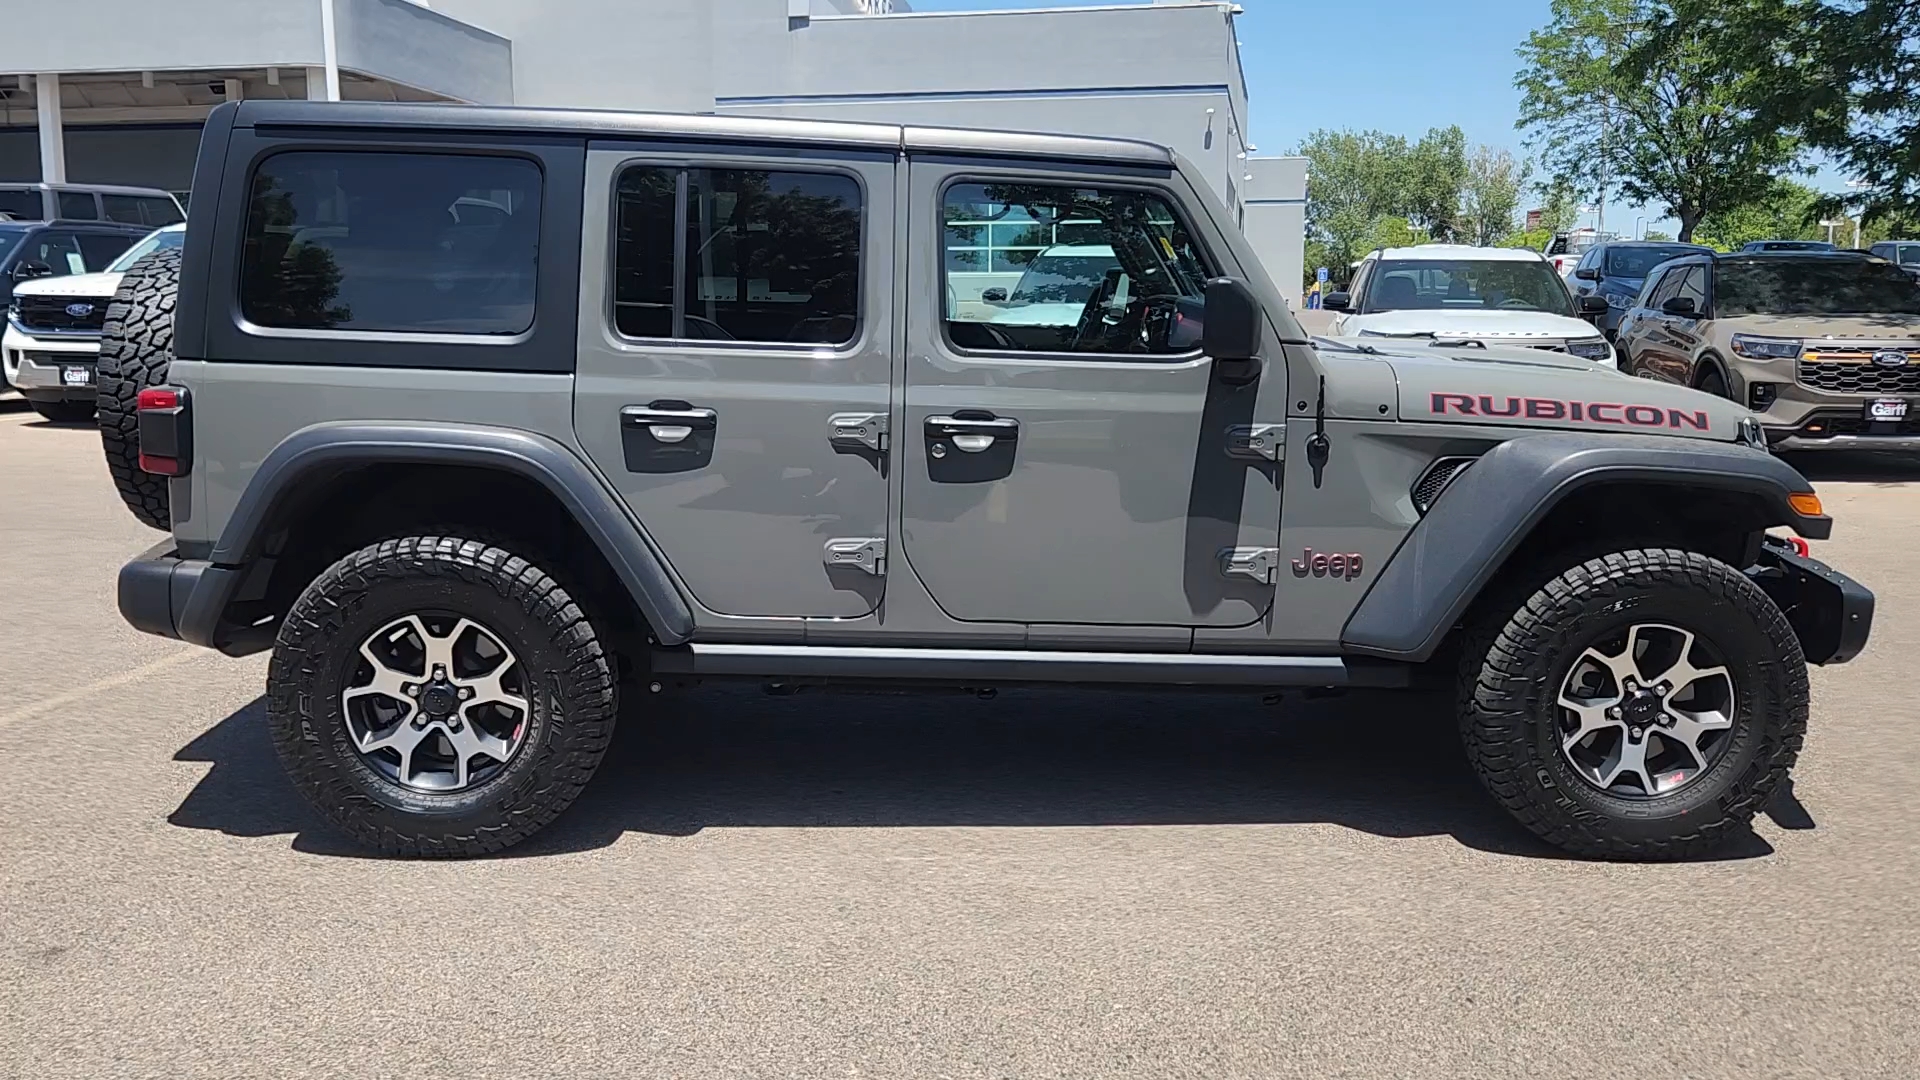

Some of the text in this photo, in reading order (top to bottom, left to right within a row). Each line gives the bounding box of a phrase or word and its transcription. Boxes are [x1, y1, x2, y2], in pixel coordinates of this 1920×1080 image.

[64, 370, 90, 382] Garff
[1430, 392, 1710, 431] RUBICON
[1871, 403, 1907, 416] Garff
[1291, 546, 1363, 581] Jeep
